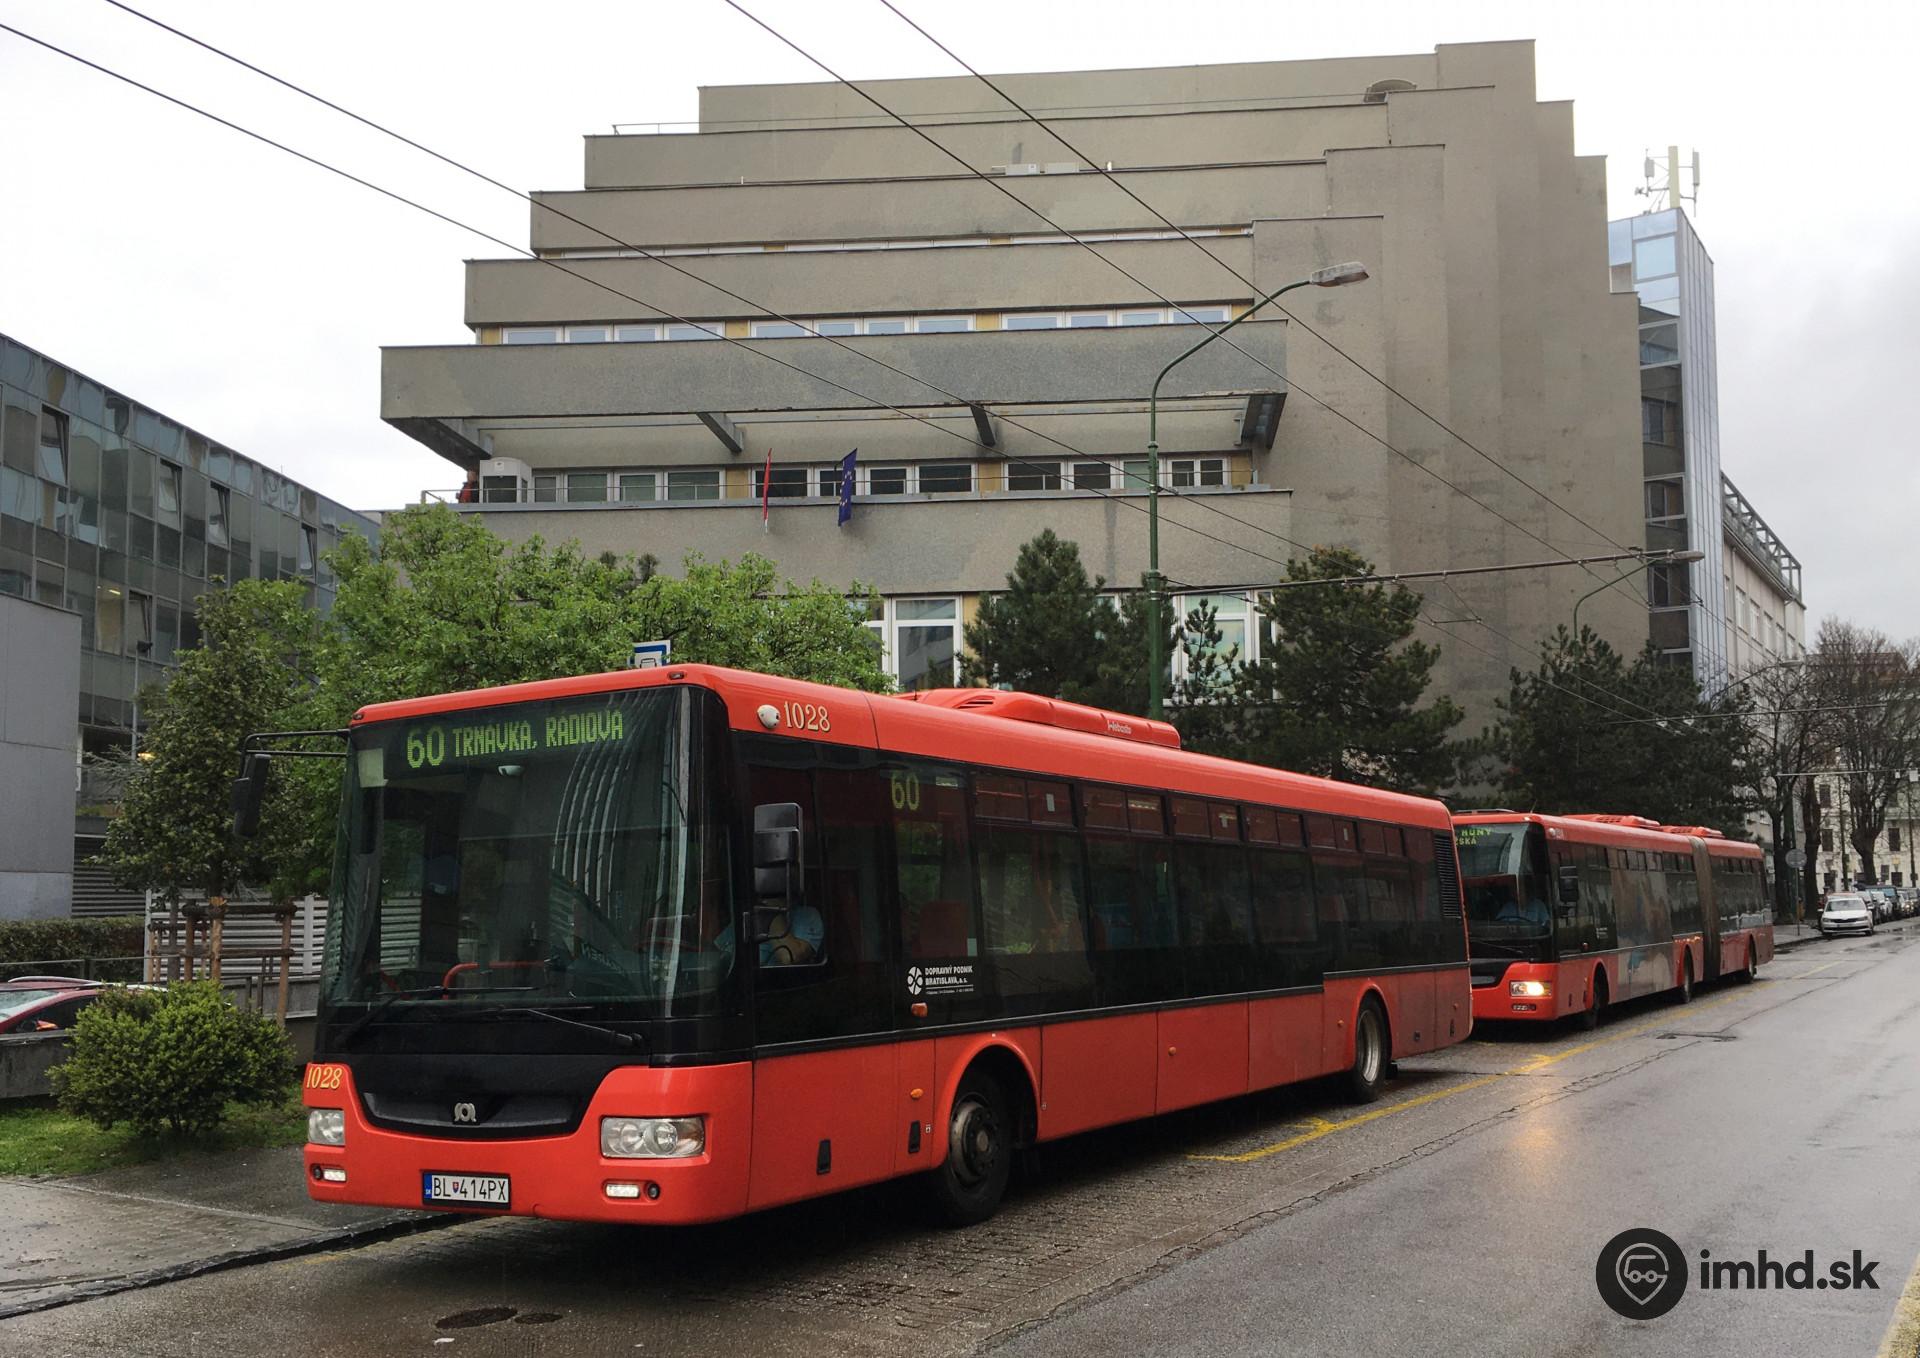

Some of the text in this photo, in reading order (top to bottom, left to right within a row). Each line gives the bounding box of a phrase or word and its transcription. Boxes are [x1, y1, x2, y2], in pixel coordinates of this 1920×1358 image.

[784, 701, 831, 732] 1028
[407, 725, 445, 768] 60
[891, 769, 920, 810] 60
[953, 965, 973, 975] PODNIK
[306, 1066, 343, 1089] 1028
[433, 1177, 506, 1201] BL 414PX
